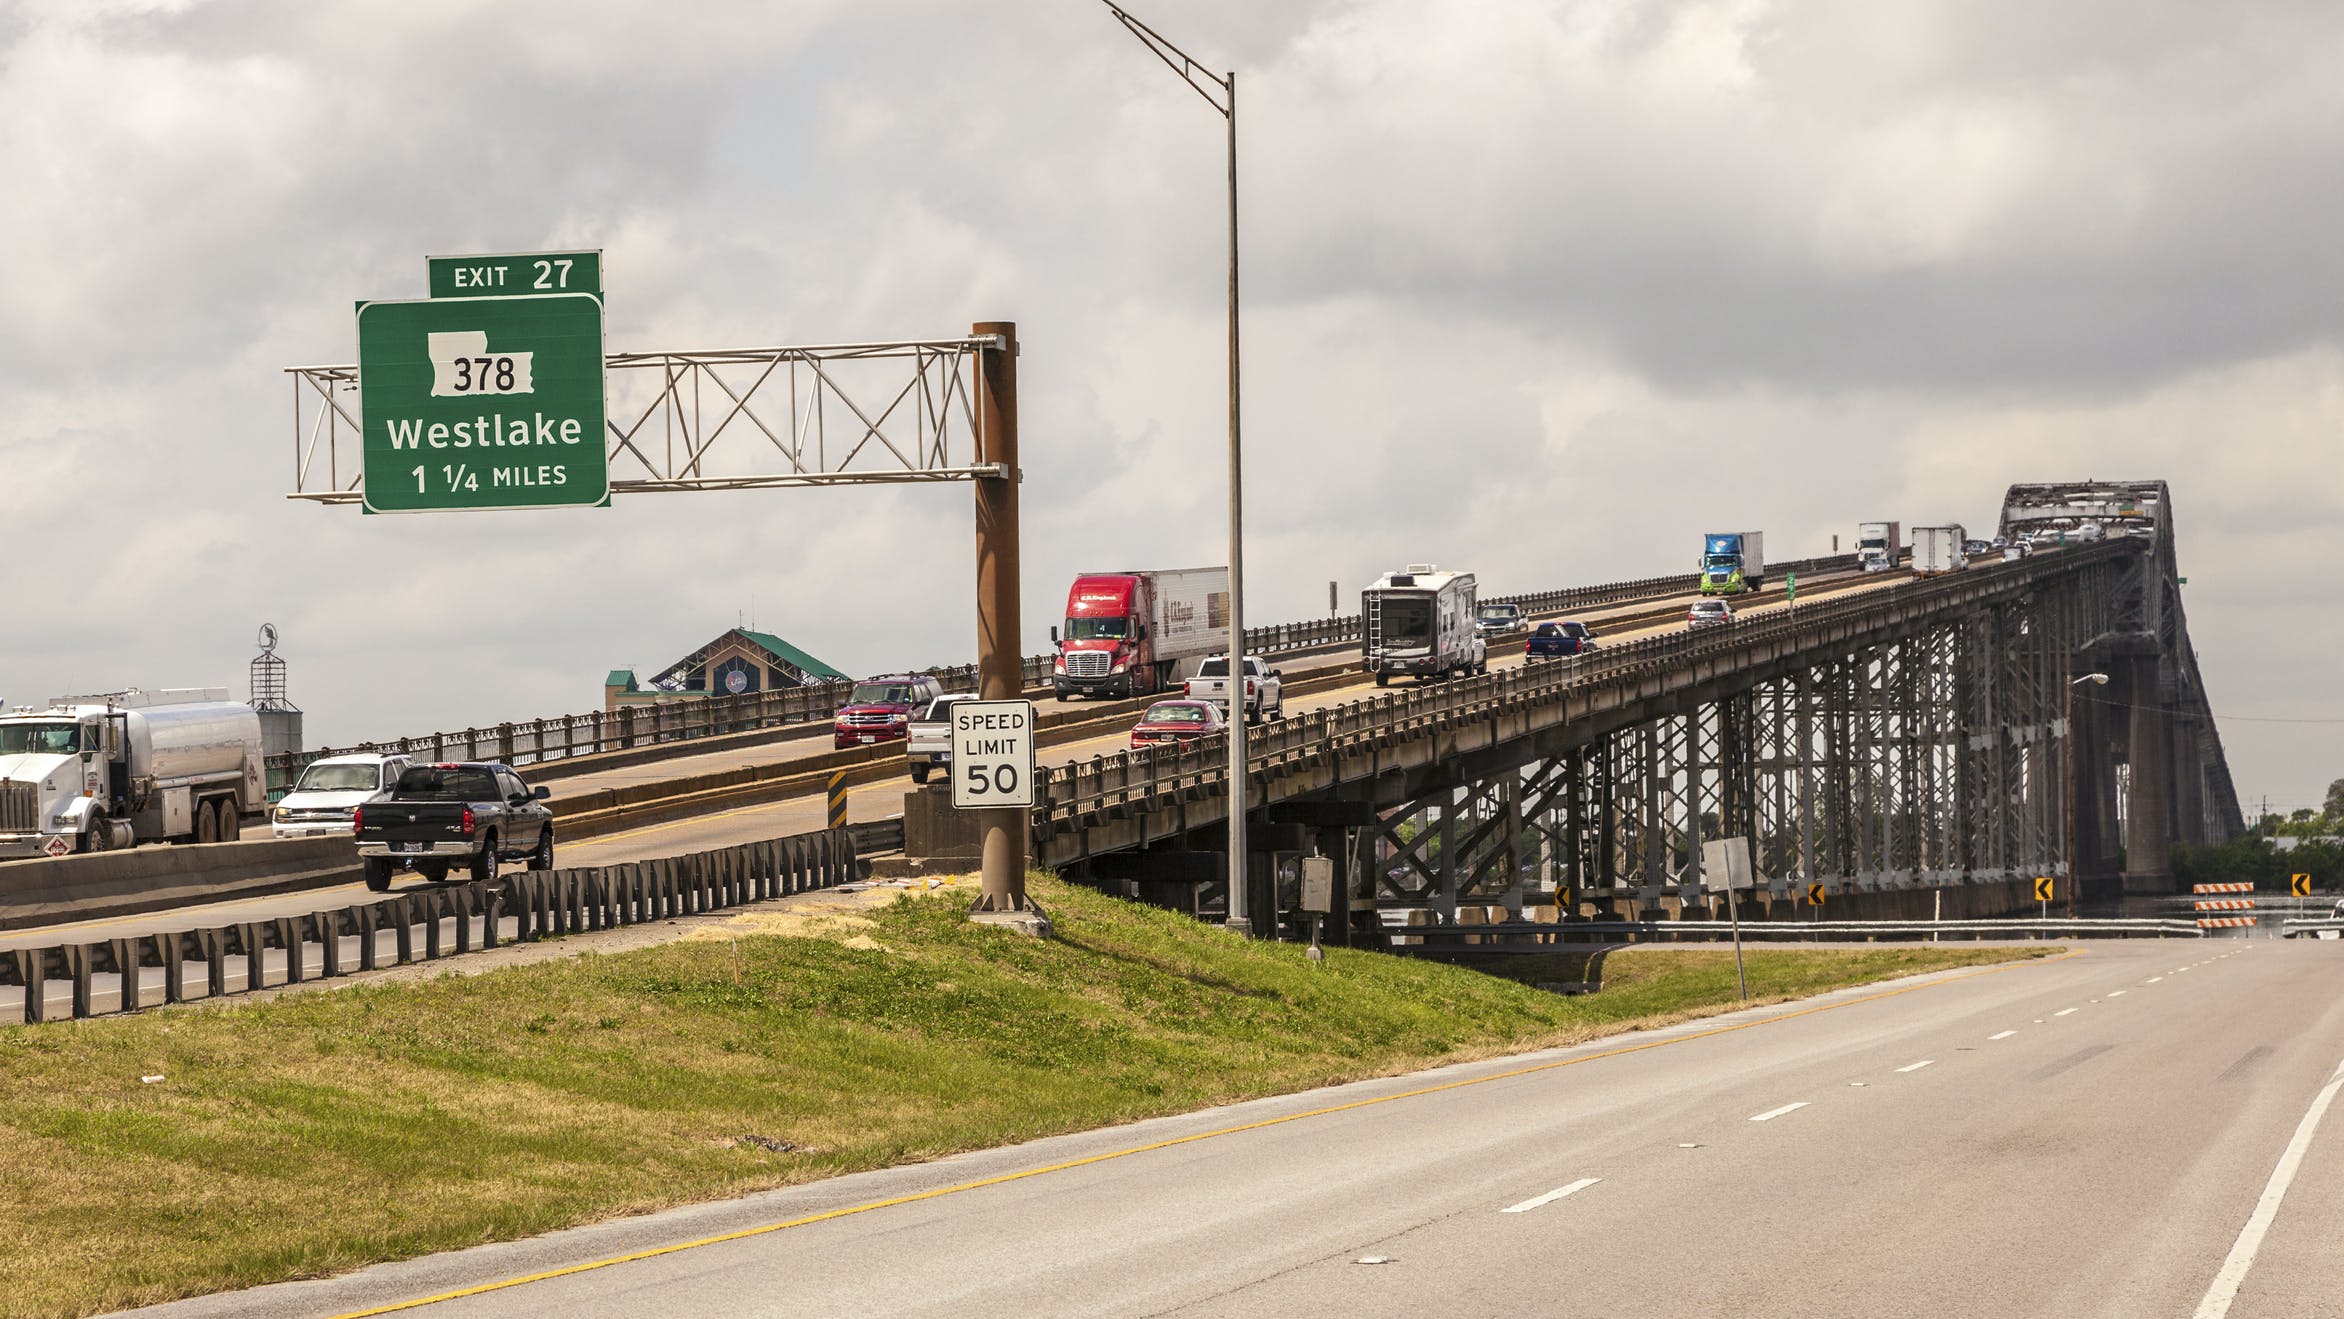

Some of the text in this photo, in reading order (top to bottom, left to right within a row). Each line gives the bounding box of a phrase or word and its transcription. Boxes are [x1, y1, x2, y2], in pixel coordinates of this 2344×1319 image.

[454, 259, 574, 289] EXIT 27
[453, 357, 515, 392] 378
[386, 412, 582, 450] Westlake
[411, 465, 426, 494] 1
[493, 465, 567, 487] MILES
[959, 714, 1024, 731] SPEED
[966, 738, 1017, 756] LIMIT
[967, 763, 1018, 795] 50
